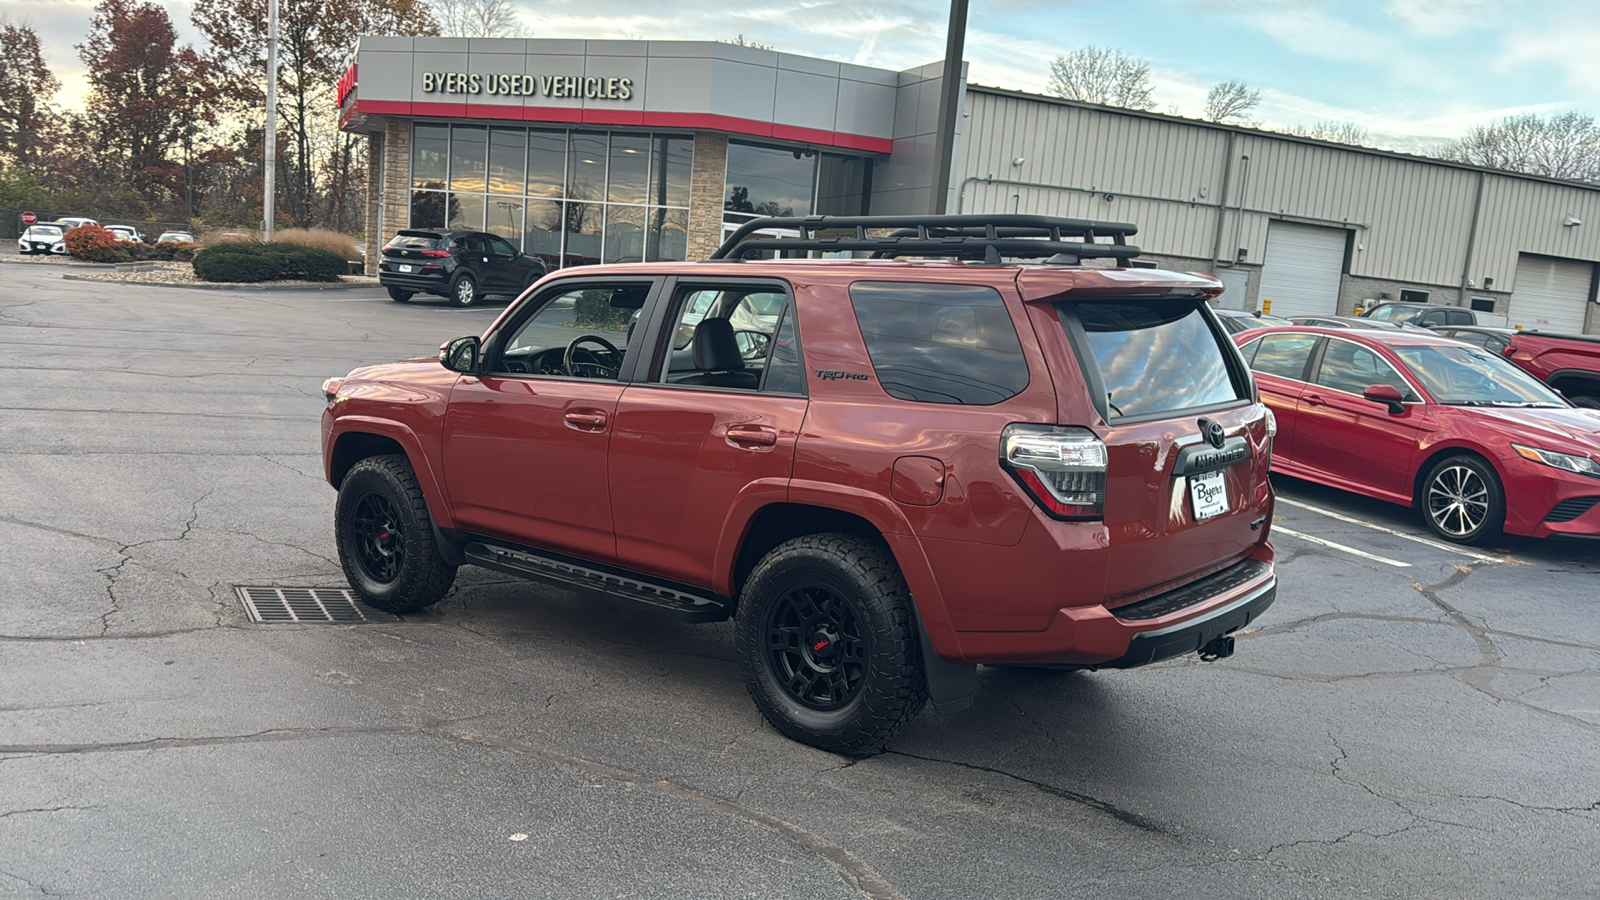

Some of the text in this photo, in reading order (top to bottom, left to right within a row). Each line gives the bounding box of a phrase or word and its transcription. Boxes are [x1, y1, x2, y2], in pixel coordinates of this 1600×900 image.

[422, 71, 632, 100] BYERS USED VEHICLES
[815, 369, 868, 381] TRD PRO
